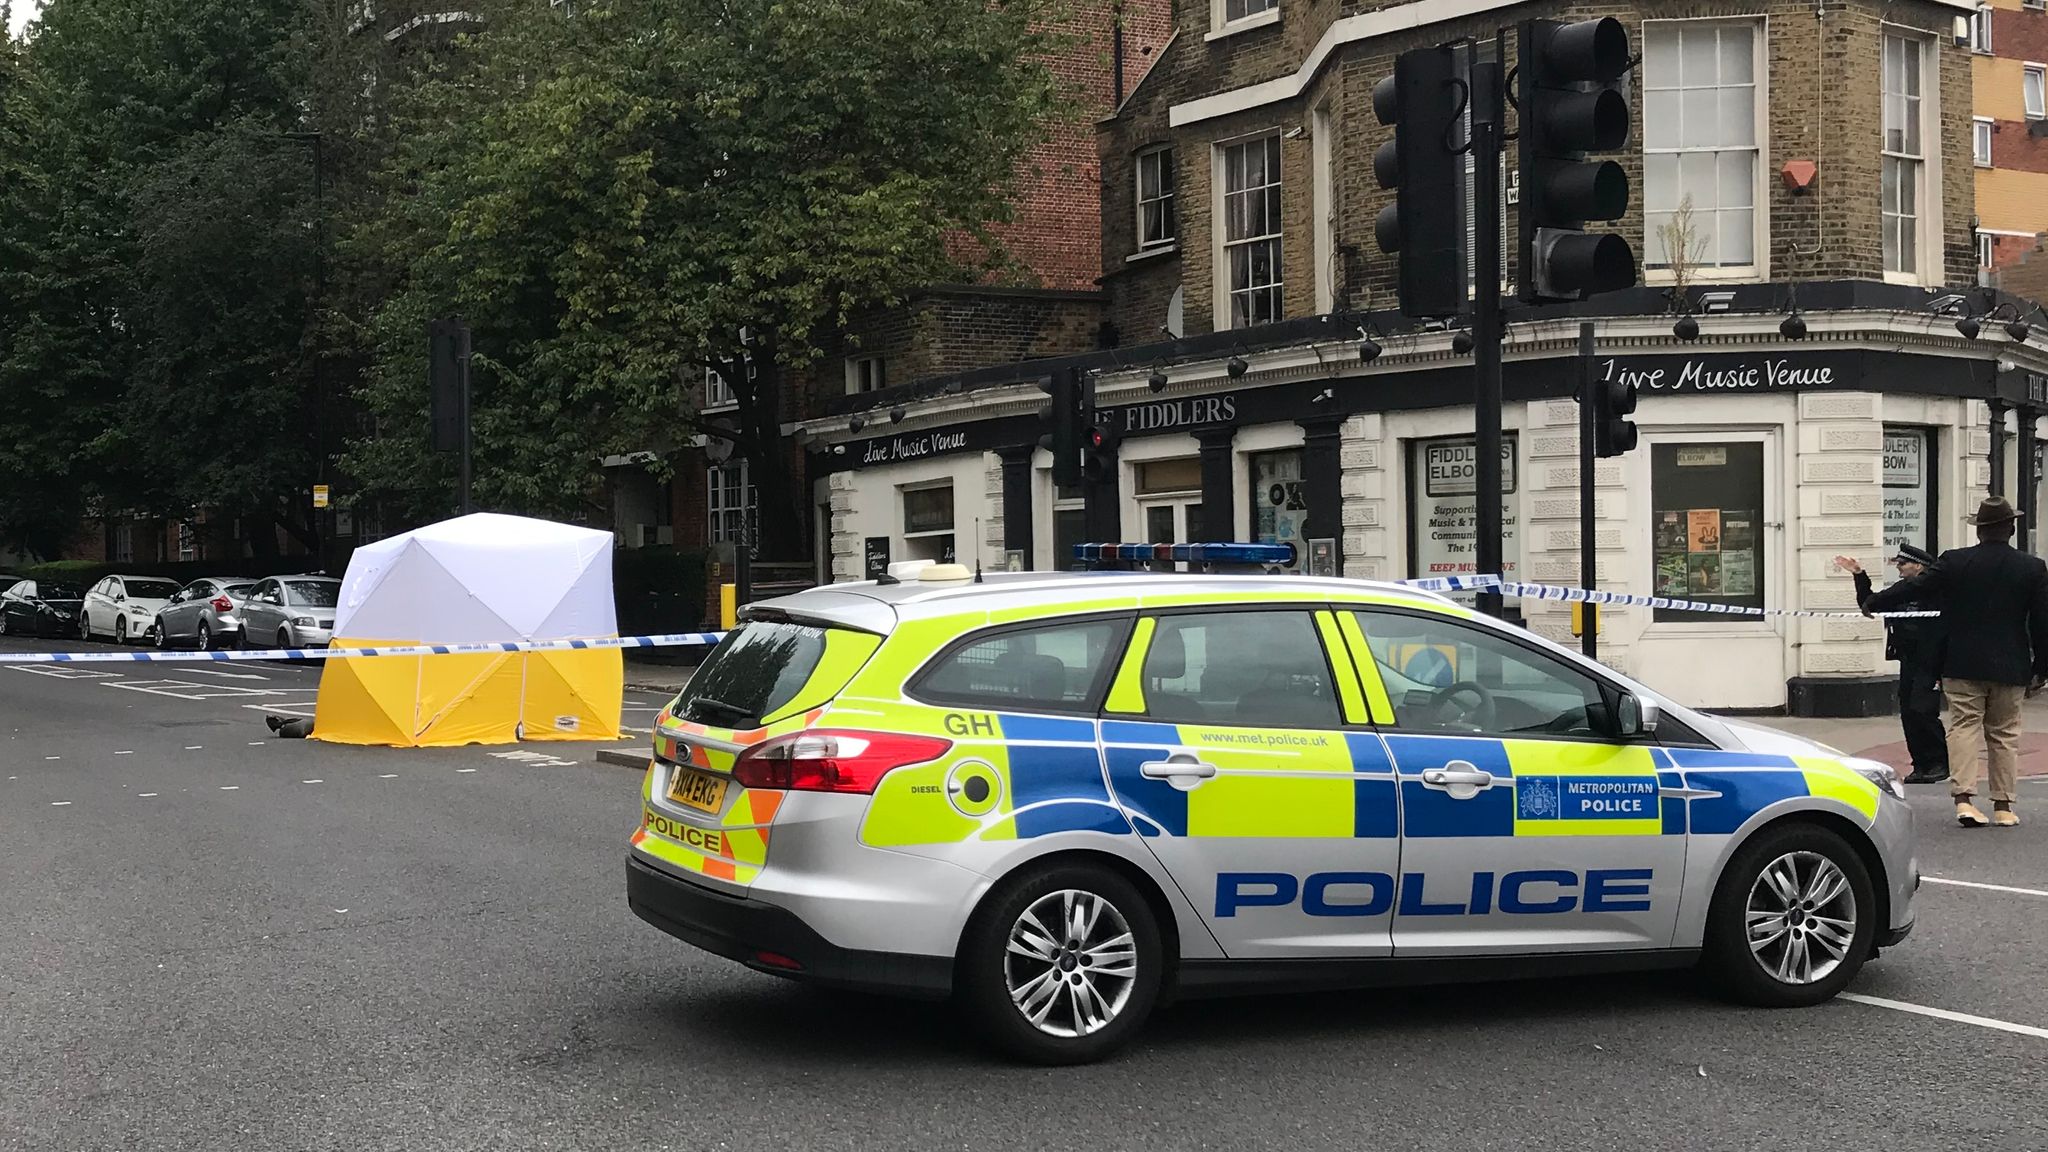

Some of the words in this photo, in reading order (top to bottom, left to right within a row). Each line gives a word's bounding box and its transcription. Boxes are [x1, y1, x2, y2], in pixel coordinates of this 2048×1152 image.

[1671, 360, 1759, 390] Music
[1764, 359, 1834, 388] Venue
[1124, 395, 1237, 432] FIDDLERS
[863, 440, 888, 463] Live
[891, 437, 929, 460] Music
[931, 432, 967, 453] Venue
[1882, 438, 1919, 454] DLER'S
[1882, 455, 1907, 469] BOW
[1430, 464, 1475, 479] ELBO
[1433, 504, 1477, 516] Supporti
[1428, 518, 1456, 527] Music
[1458, 517, 1466, 527] &
[1431, 530, 1477, 540] Communi
[1447, 543, 1465, 552] The
[1429, 563, 1456, 572] KEEP
[800, 626, 823, 639] NOW
[944, 713, 994, 736] GH
[1200, 733, 1329, 747] www.met.police.uk
[692, 775, 718, 806] EKG
[911, 786, 942, 794] DIESEL
[1568, 782, 1654, 794] METROPOLITAN
[1581, 799, 1643, 812] POLICE
[646, 812, 720, 853] POLICE
[1214, 868, 1654, 918] POLICE
